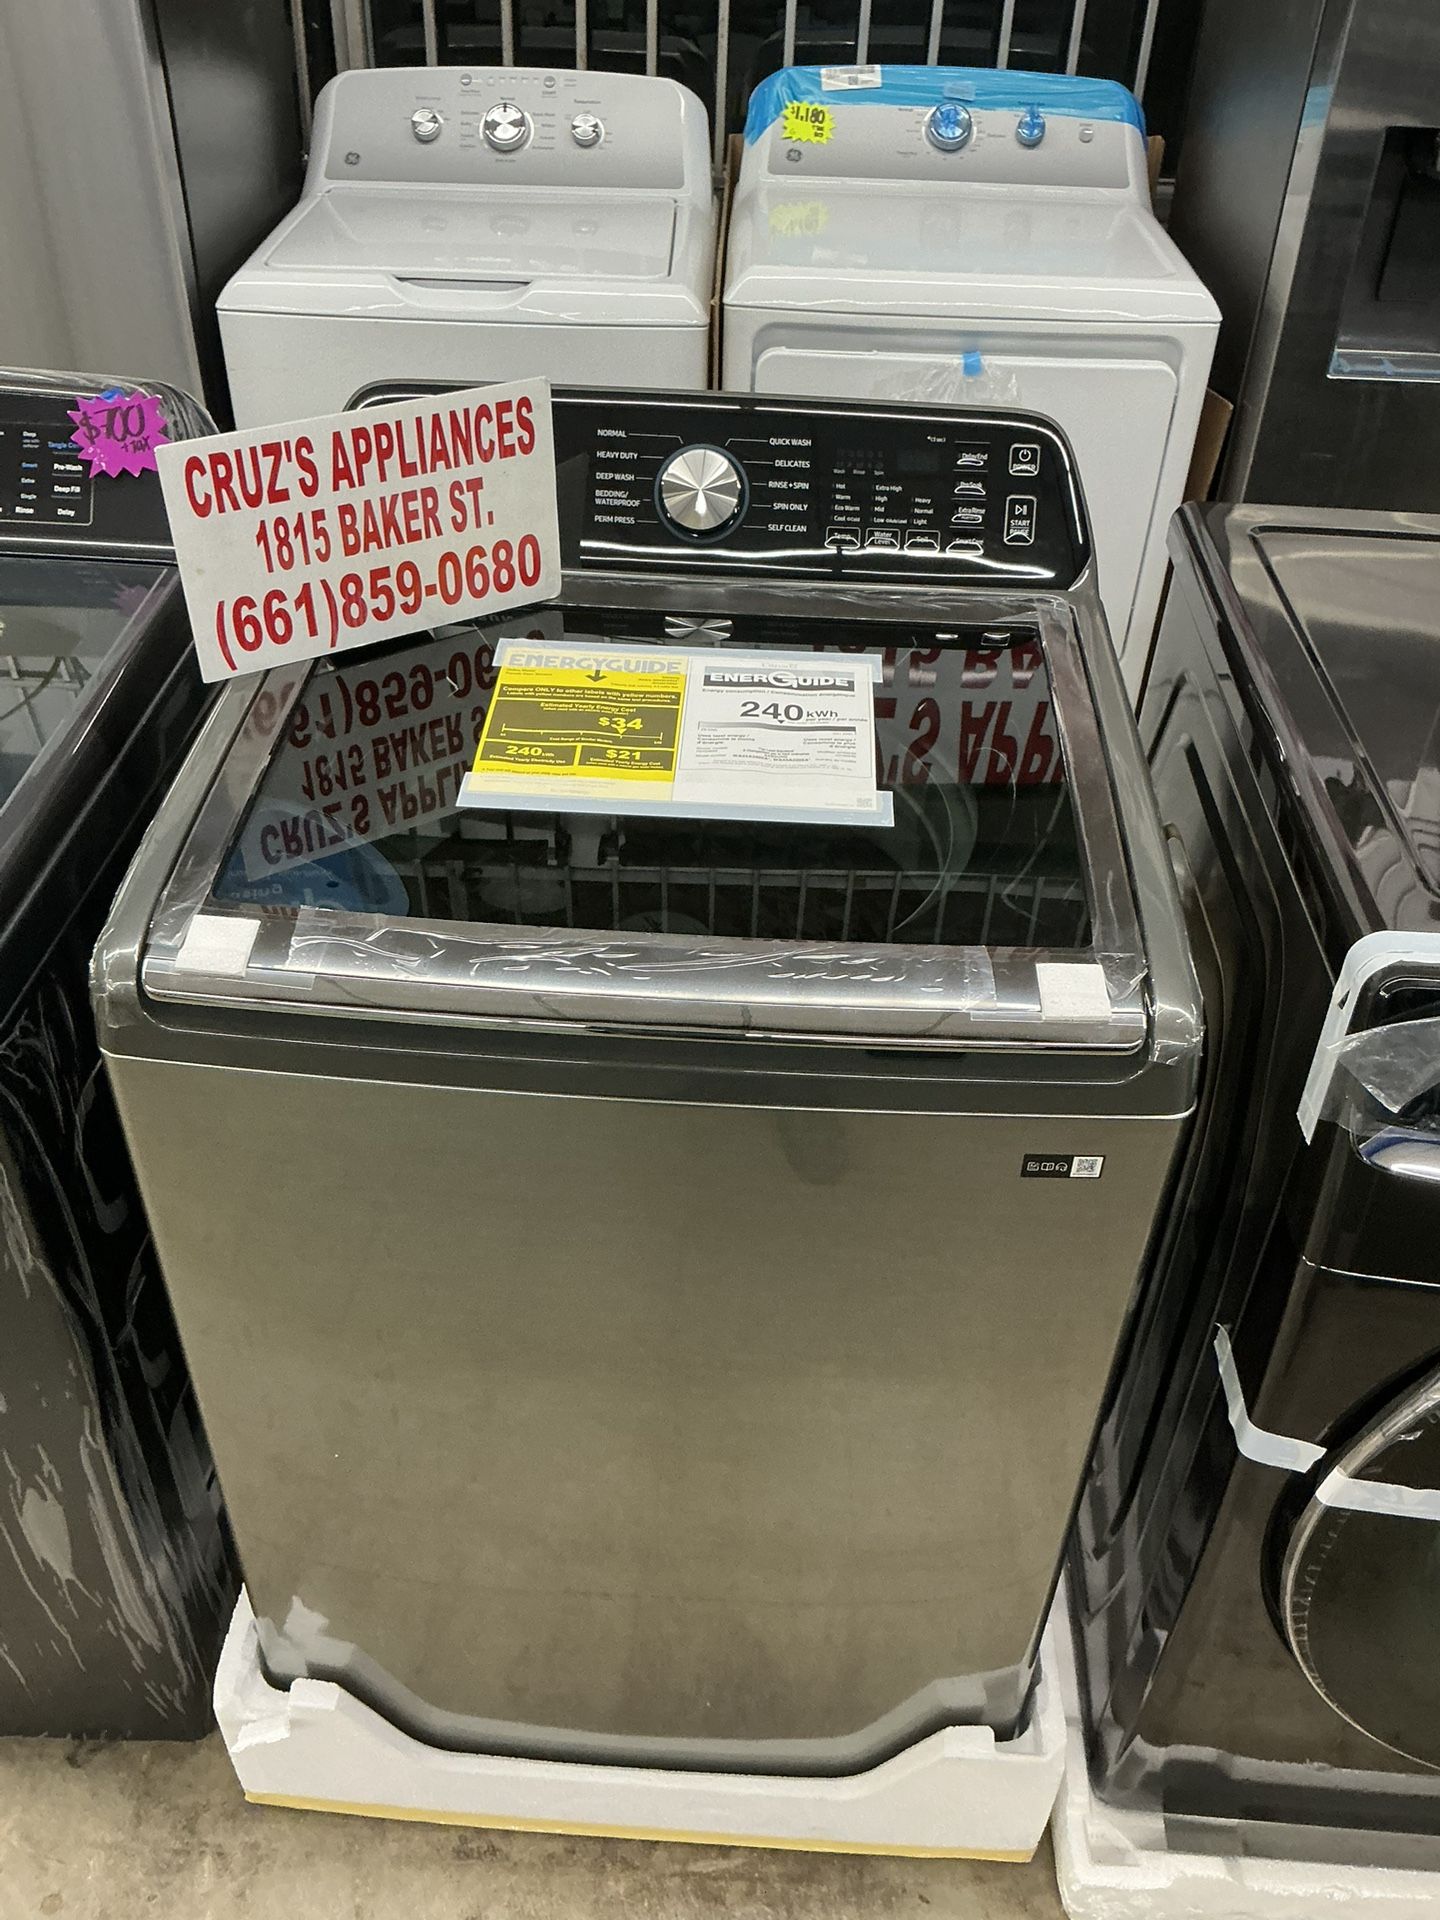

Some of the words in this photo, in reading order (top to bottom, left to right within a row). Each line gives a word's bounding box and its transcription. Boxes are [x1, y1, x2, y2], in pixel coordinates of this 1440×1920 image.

[79, 404, 145, 445] $700
[597, 429, 627, 438] NORMAL
[769, 438, 790, 447] QUICK
[791, 438, 812, 447] WASH
[184, 435, 320, 518] CRUZ'S
[332, 395, 536, 493] APPLIANCES
[597, 451, 619, 460] HEAVY
[620, 451, 638, 460] DUTY
[775, 460, 810, 468] DELICATES
[596, 472, 613, 480] DEEP
[614, 473, 635, 481] WASH
[53, 486, 70, 494] Deep
[793, 482, 810, 490] SPIN
[595, 489, 629, 498] BEDDING/
[595, 498, 641, 507] WATERPROOF
[773, 502, 789, 511] SPIN
[790, 503, 808, 511] ONLY
[57, 508, 76, 517] Delay
[594, 515, 613, 524] PERM
[614, 516, 635, 524] PRESS
[255, 508, 332, 574] 1815
[338, 486, 441, 558] BAKER
[450, 479, 495, 537] ST.
[768, 524, 784, 532] SELF
[785, 524, 807, 533] CLEAN
[215, 534, 543, 671] (661)859-0680
[509, 653, 682, 674] ENERGYGUIDE
[710, 671, 850, 688] ENERGUIDE
[740, 701, 803, 721] 240
[807, 710, 838, 718] kWh
[598, 716, 644, 730] $34
[506, 746, 542, 756] 240
[605, 750, 641, 760] $21
